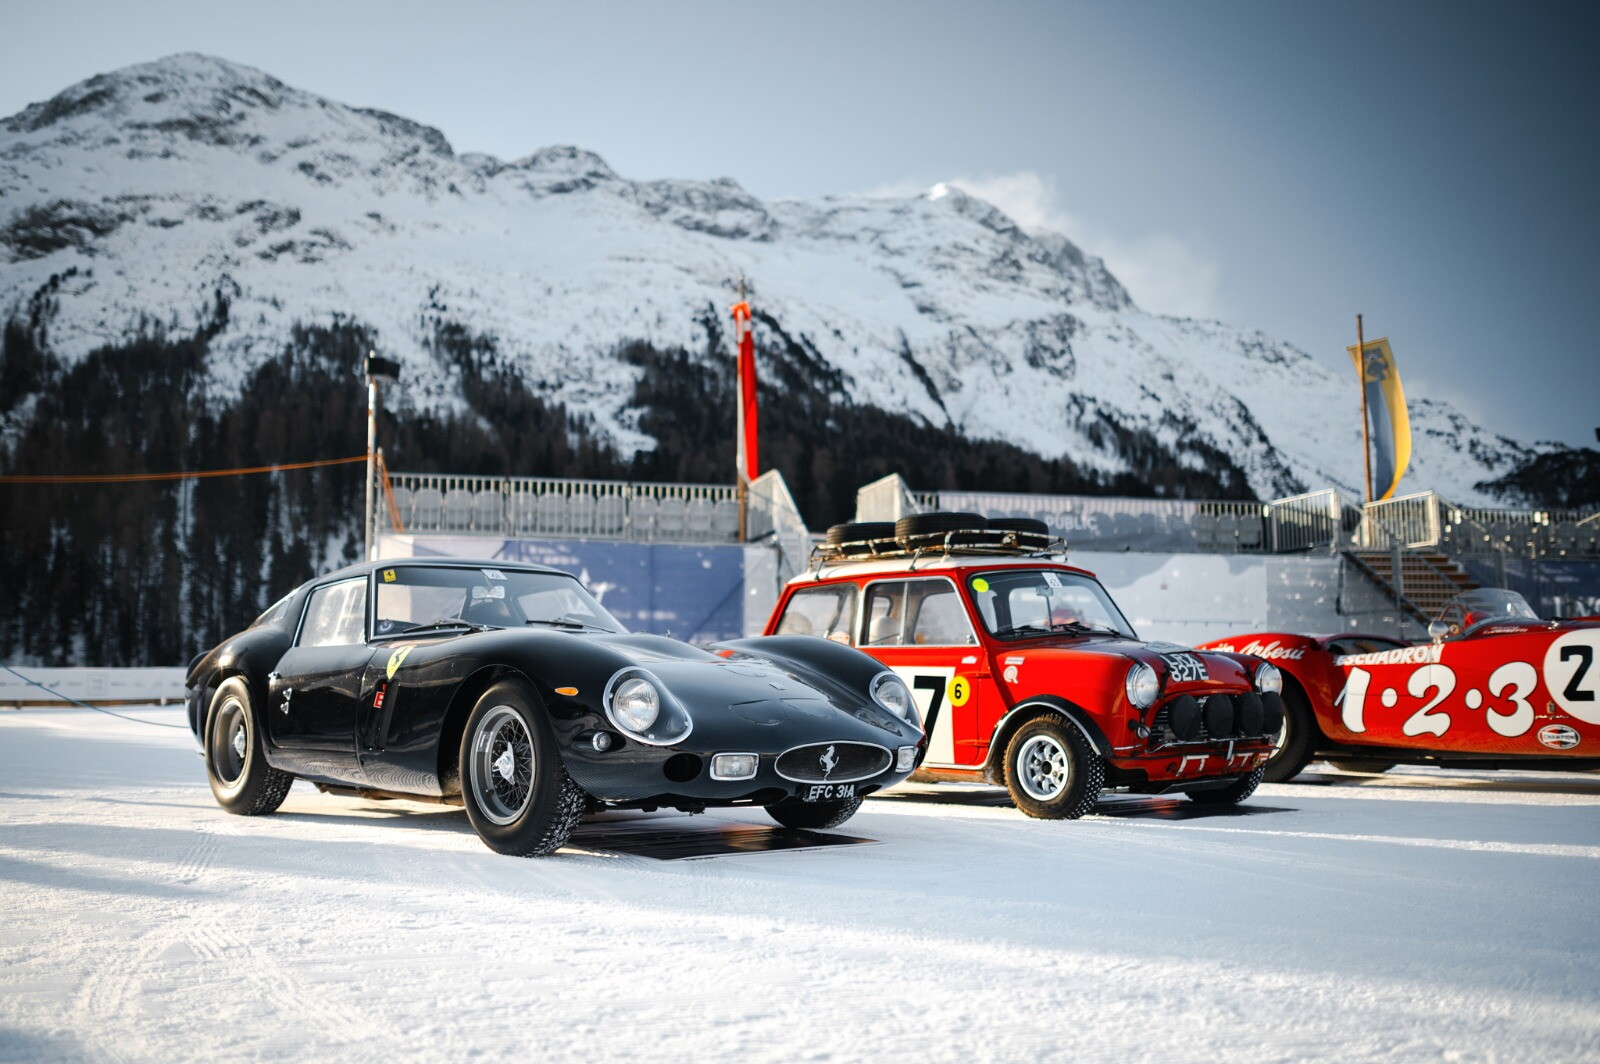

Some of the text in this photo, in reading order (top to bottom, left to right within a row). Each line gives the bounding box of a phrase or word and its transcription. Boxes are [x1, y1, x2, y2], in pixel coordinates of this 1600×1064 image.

[1044, 515, 1098, 531] PUBLIC
[1160, 653, 1199, 666] LRX
[1334, 643, 1445, 666] ESCUADRON
[1169, 664, 1209, 682] 827E
[1560, 644, 1595, 702] 2
[954, 683, 963, 700] 6
[913, 675, 947, 757] 7
[808, 784, 855, 799] EFC 31A
